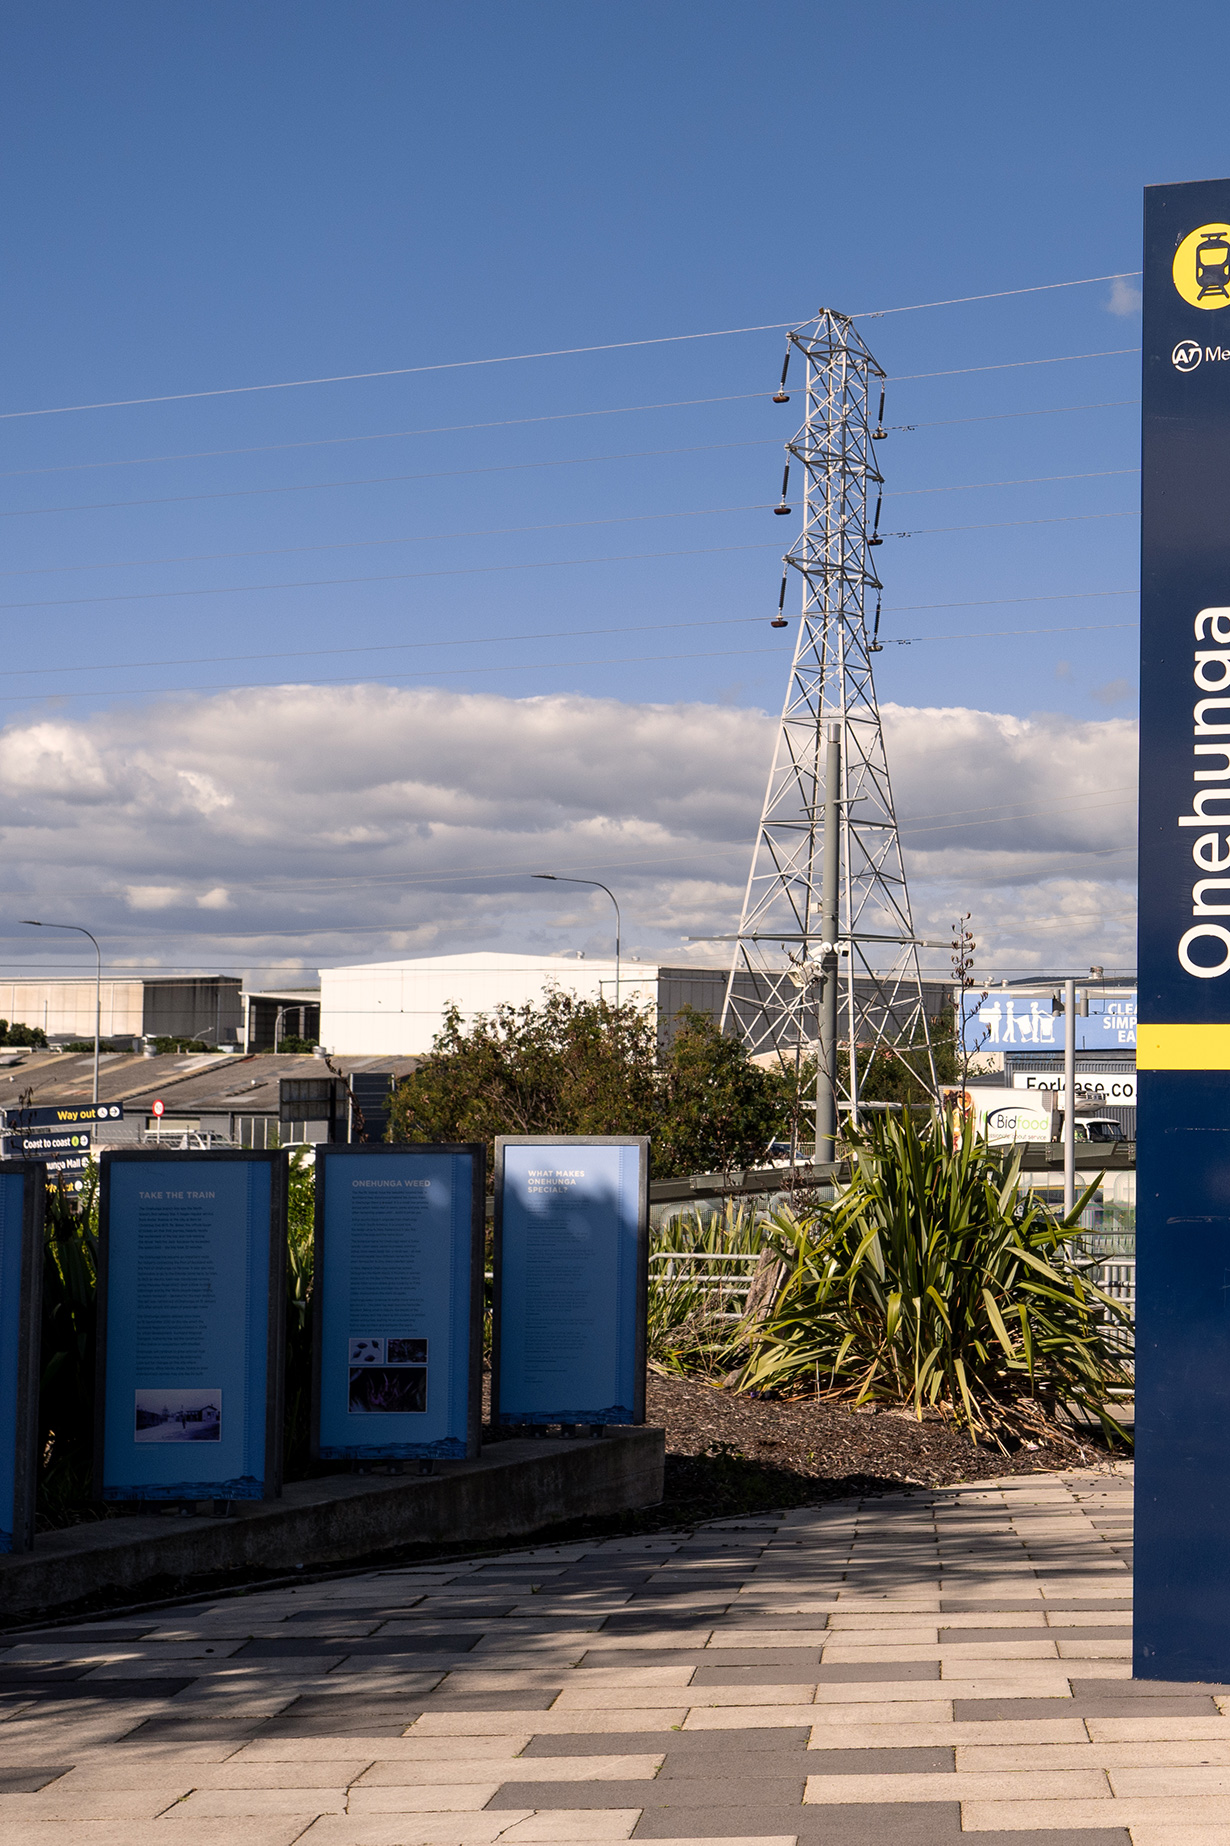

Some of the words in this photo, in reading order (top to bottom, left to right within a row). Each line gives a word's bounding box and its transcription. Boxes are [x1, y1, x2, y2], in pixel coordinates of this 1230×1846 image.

[1107, 1003, 1137, 1015] CLE
[57, 1110, 78, 1121] Way
[80, 1109, 96, 1119] out
[997, 1114, 1049, 1130] Bidfood
[23, 1139, 43, 1149] Coast
[43, 1138, 51, 1148] to
[52, 1137, 71, 1148] coast
[66, 1158, 81, 1168] Mall
[352, 1180, 402, 1188] ONEHUNGA
[139, 1191, 163, 1199] TAKE
[165, 1191, 184, 1199] THE
[186, 1191, 215, 1199] TRAIN
